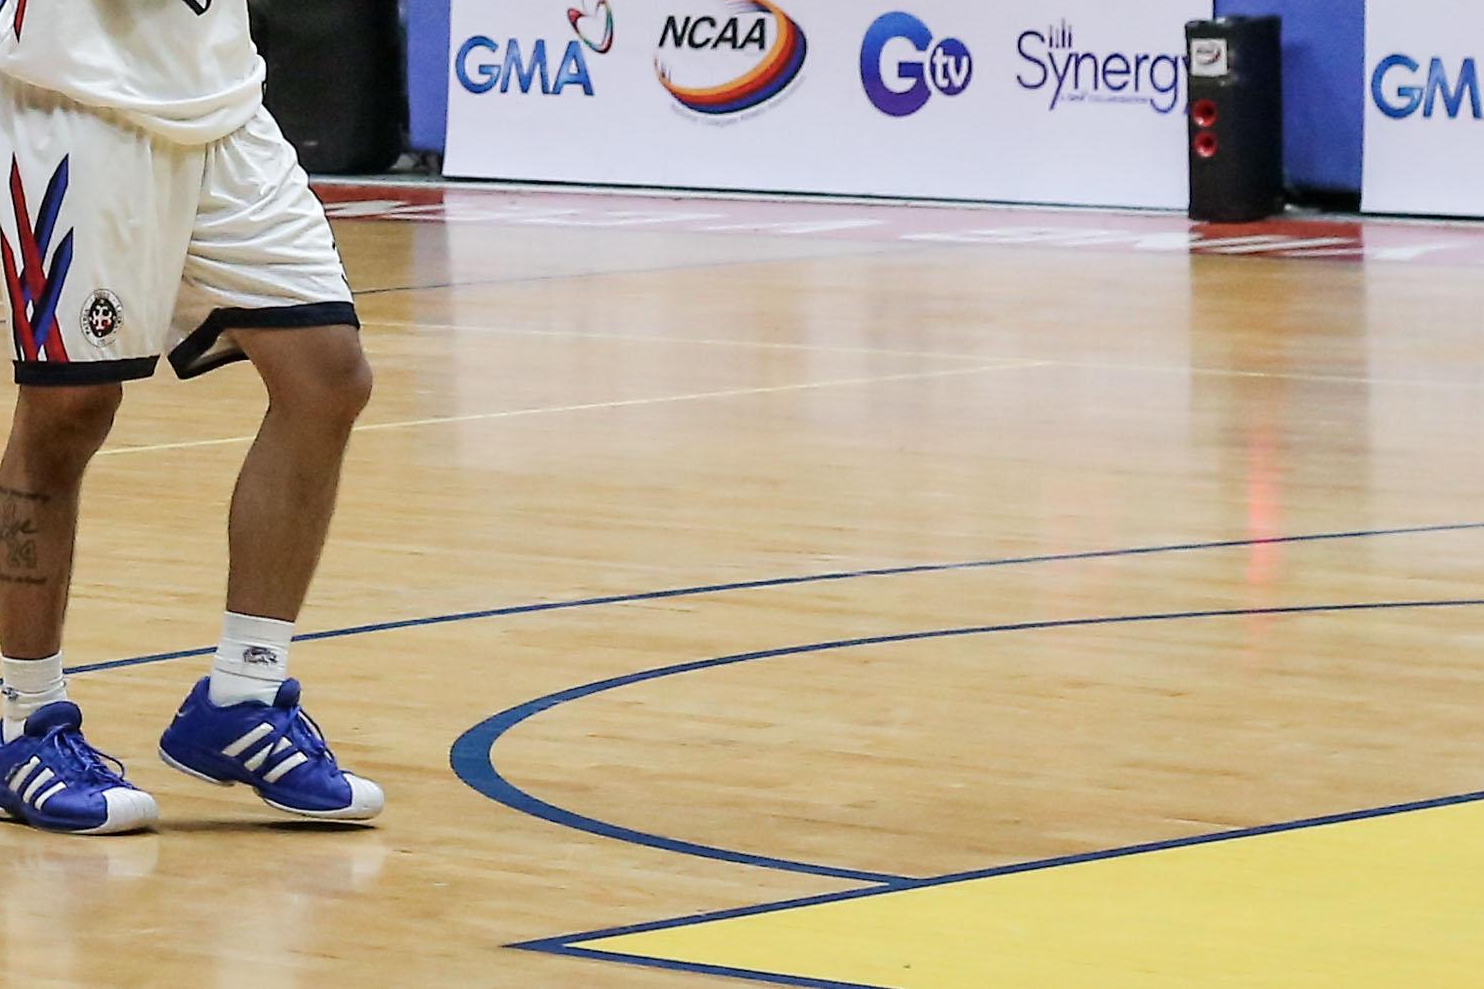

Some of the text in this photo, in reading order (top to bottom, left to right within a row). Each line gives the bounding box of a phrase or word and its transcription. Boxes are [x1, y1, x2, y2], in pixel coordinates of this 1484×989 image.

[454, 34, 595, 97] GMA
[657, 16, 766, 51] NCAA
[1016, 28, 1192, 114] Synerg
[1371, 53, 1484, 119] GM
